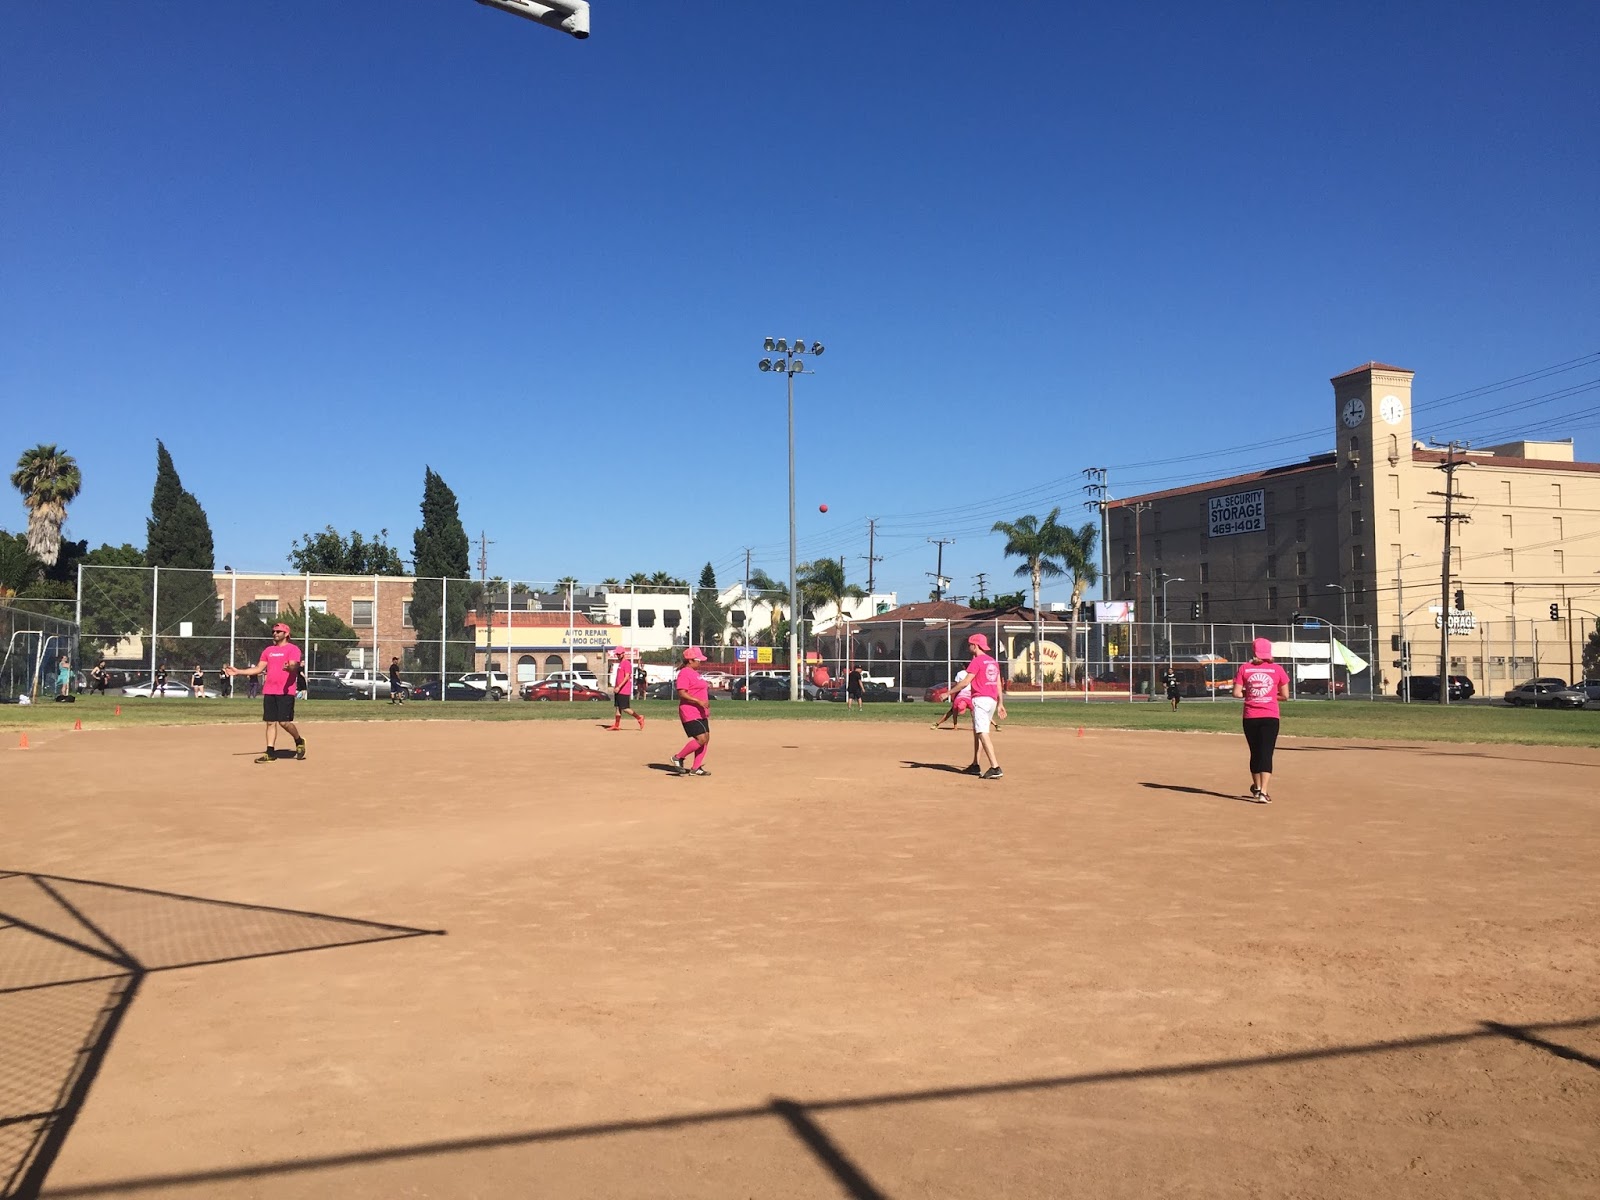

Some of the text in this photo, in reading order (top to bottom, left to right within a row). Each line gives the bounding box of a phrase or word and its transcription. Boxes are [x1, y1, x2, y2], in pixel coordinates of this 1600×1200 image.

[1225, 491, 1262, 507] SECURITY
[1211, 503, 1262, 523] STORAGE
[1212, 519, 1261, 534] 469-1402
[1436, 616, 1477, 628] SORAGE
